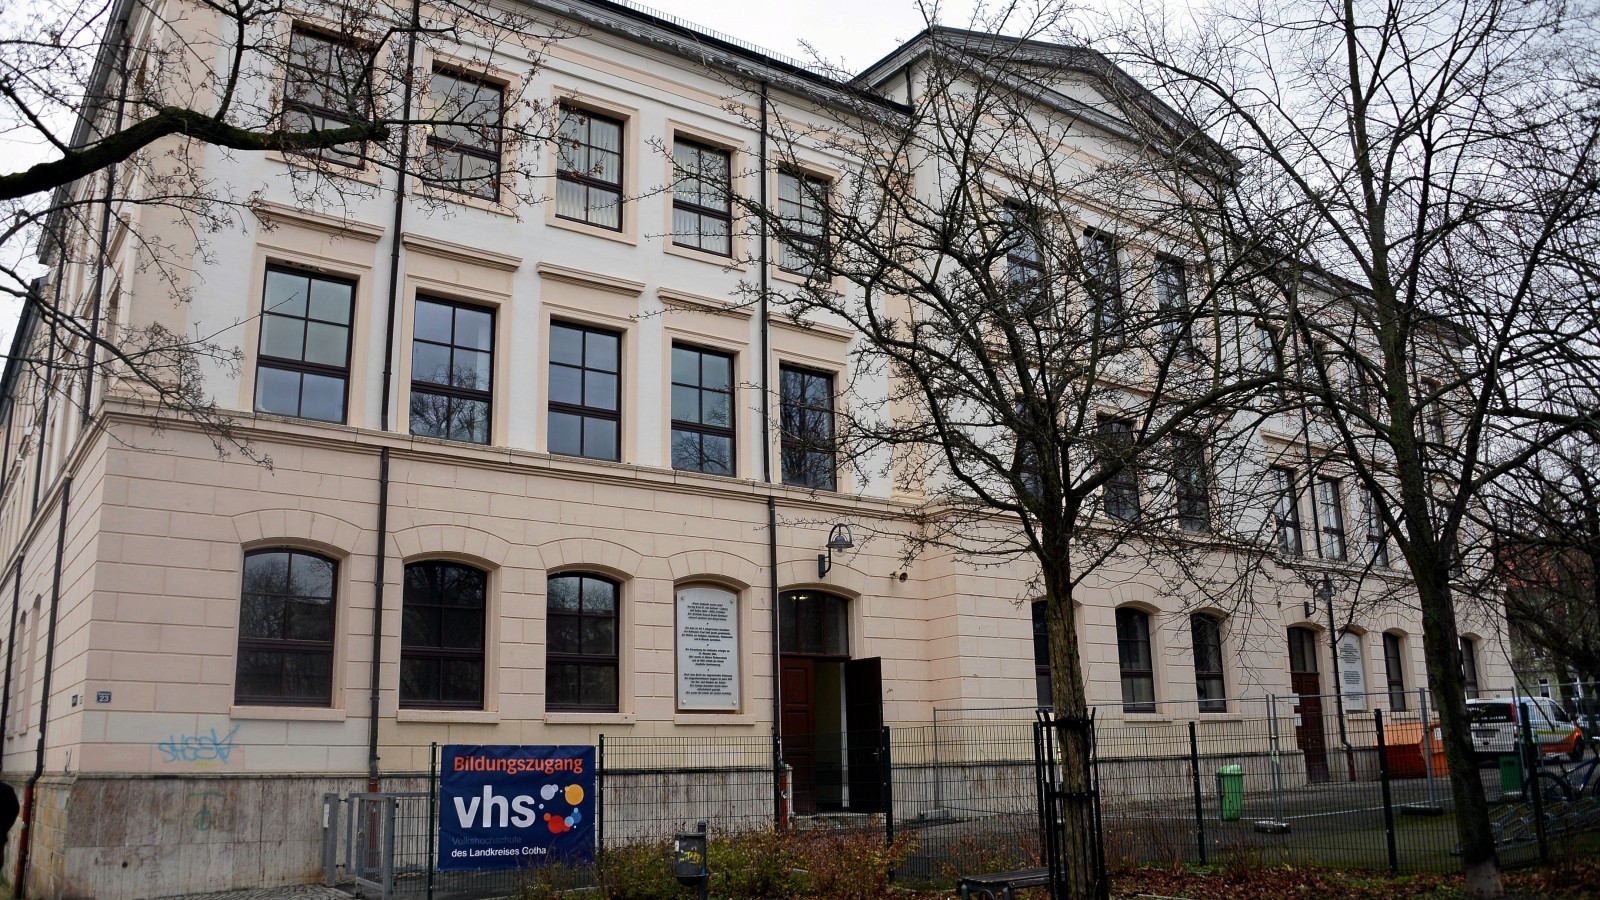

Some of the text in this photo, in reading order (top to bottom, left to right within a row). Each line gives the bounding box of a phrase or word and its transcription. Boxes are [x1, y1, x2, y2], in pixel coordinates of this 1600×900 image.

[453, 756, 584, 774] Bildungszugang
[453, 785, 536, 828] vhs
[451, 835, 522, 845] Volkshochschule
[451, 846, 547, 858] des Landkreises Gotha
